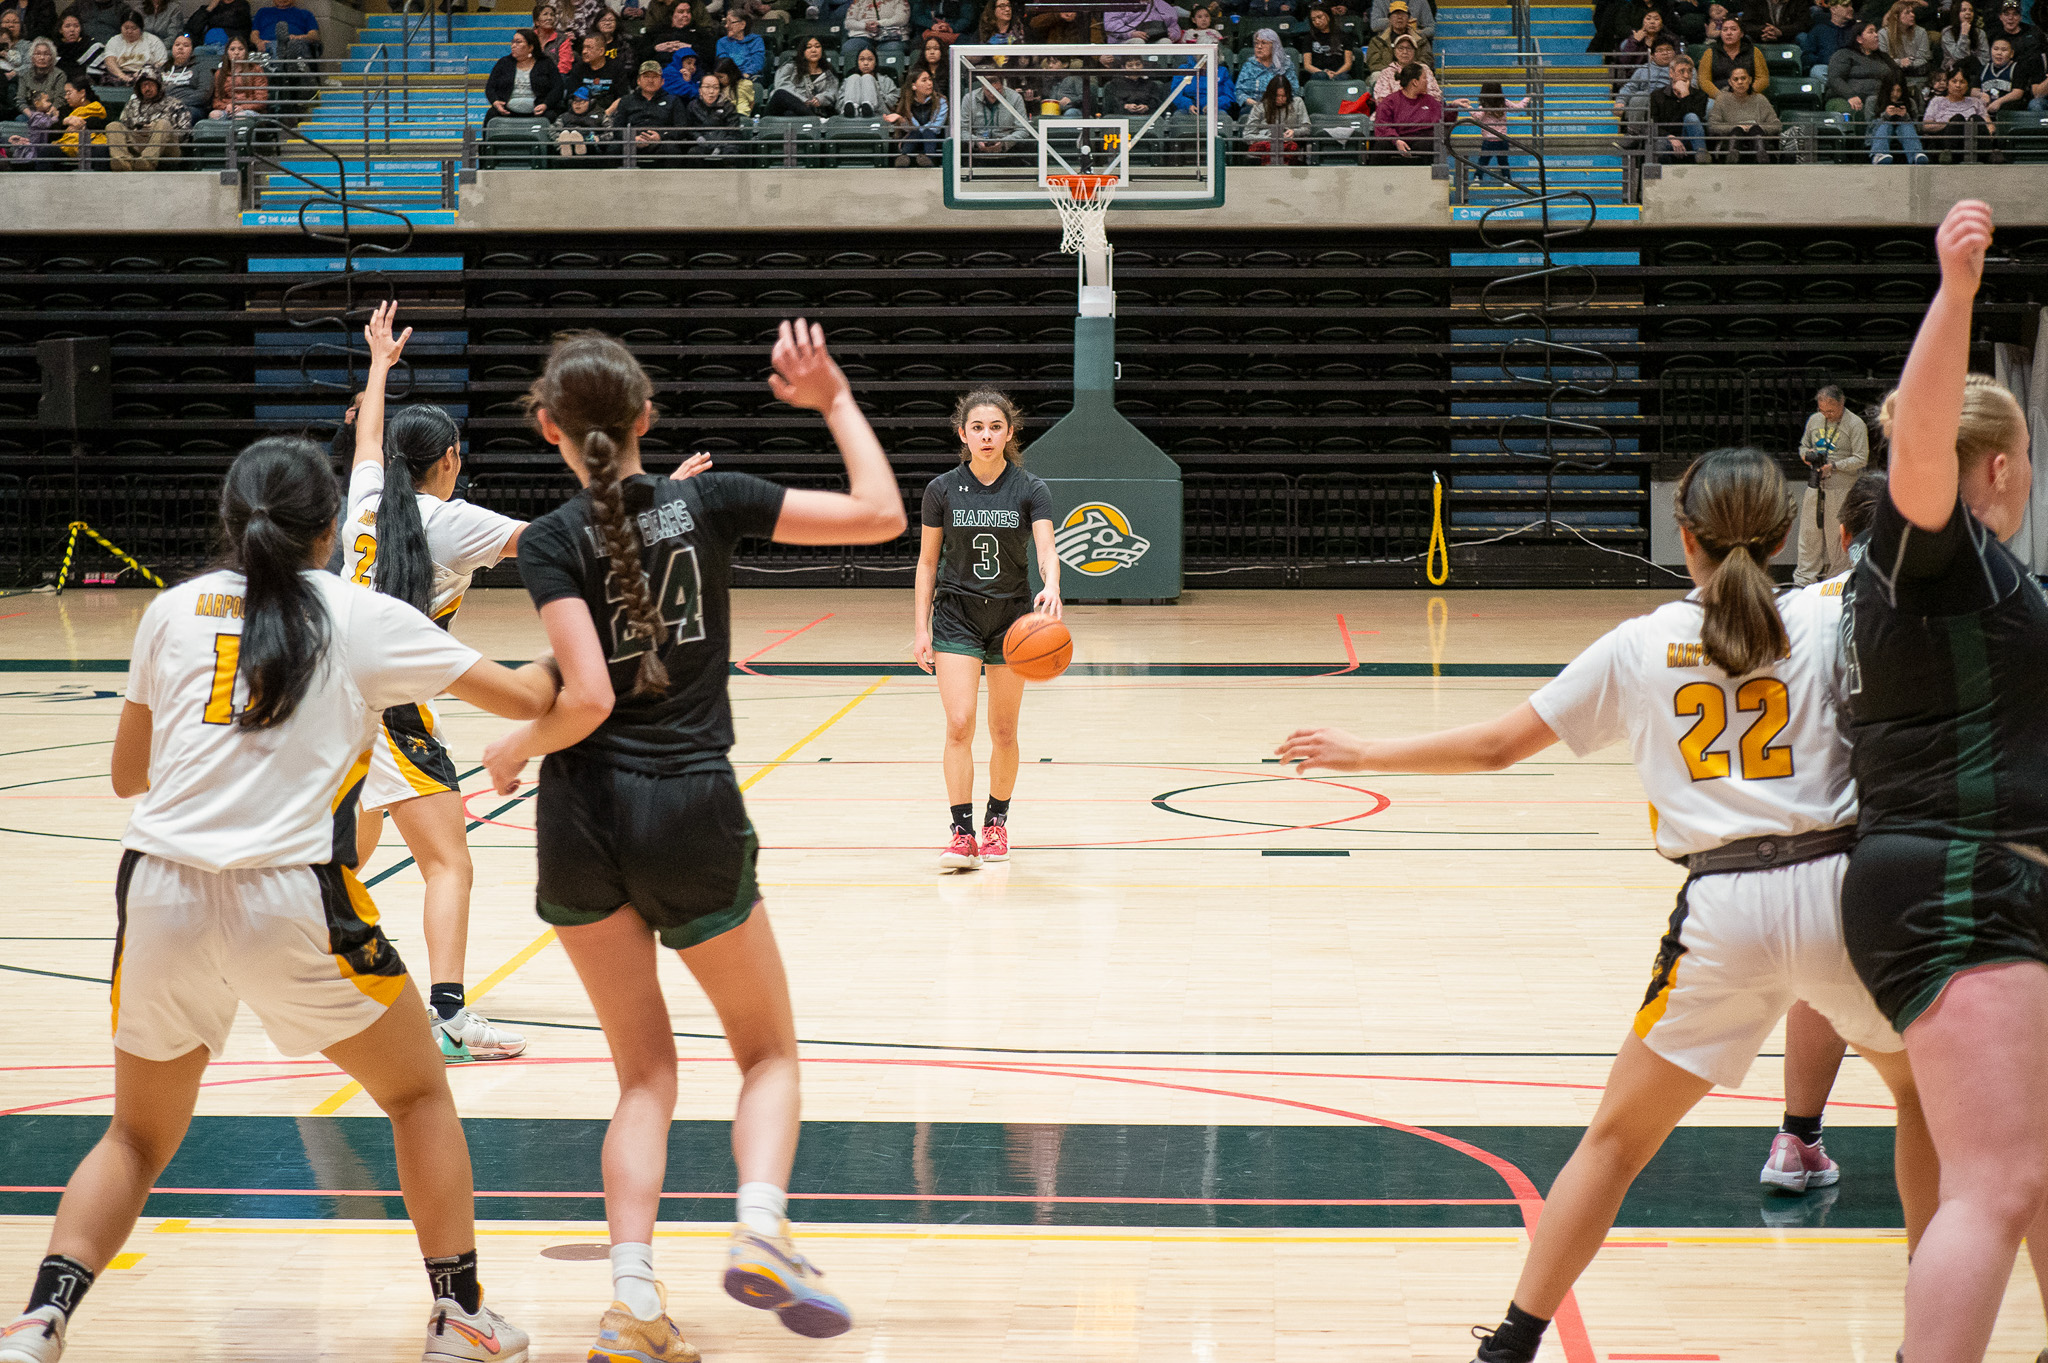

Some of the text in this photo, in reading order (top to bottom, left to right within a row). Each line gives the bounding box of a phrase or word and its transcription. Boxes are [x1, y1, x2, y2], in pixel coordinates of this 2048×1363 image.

[952, 509, 1020, 528] HAINES
[972, 533, 1001, 580] 3
[1673, 676, 1795, 783] 22
